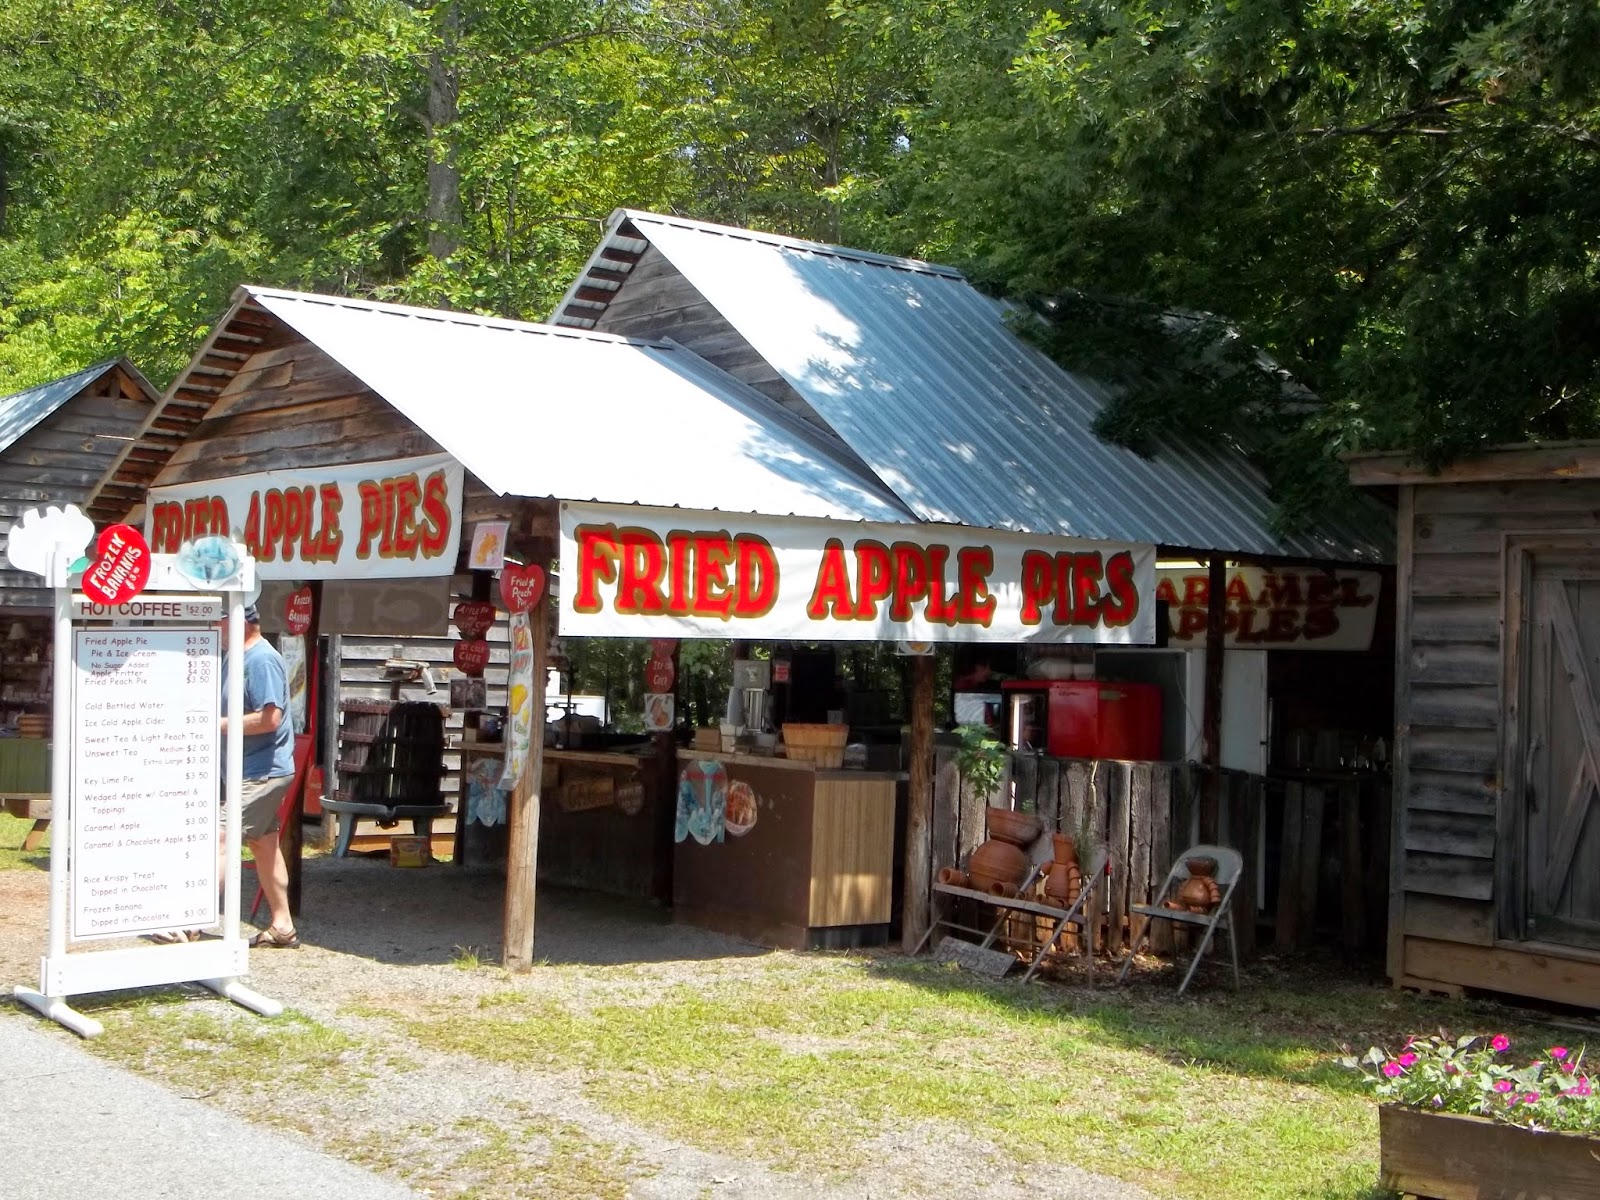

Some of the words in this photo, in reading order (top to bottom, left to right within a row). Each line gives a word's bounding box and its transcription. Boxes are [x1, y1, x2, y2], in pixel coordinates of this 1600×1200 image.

[243, 481, 344, 565] APPLE
[356, 469, 451, 561] PIES
[90, 532, 126, 589] FROZEN
[101, 545, 143, 600] BANANAS
[573, 522, 780, 622] FRIED
[806, 537, 997, 628] APPLE
[1020, 548, 1140, 629] PIES
[512, 587, 532, 599] Peach
[1156, 572, 1375, 608] ARAMEL
[119, 602, 181, 617] COFFEE
[1168, 606, 1340, 643] PLES
[85, 637, 107, 645] Fried
[111, 638, 132, 646] Apple
[136, 637, 148, 645] Pie
[187, 637, 210, 645] $3.50
[91, 669, 111, 678] Apple
[85, 678, 106, 686] Fried
[85, 702, 102, 710] Cold
[122, 718, 142, 726] Apple
[141, 734, 161, 742] Light
[84, 778, 98, 786] Key
[84, 794, 117, 802] Wedged
[121, 792, 142, 801] Apple
[92, 807, 126, 815] Toppings
[84, 824, 116, 832] Caramel
[120, 822, 141, 830] Apple
[84, 841, 114, 849] Caramel
[126, 838, 161, 847] Chocolate
[164, 836, 183, 844] Apple
[104, 874, 128, 882] Krispy
[92, 888, 118, 897] Dipped
[131, 884, 168, 892] Chocolate
[84, 906, 111, 914] Frozen
[92, 918, 119, 928] Dipped
[132, 913, 170, 922] Chocolate
